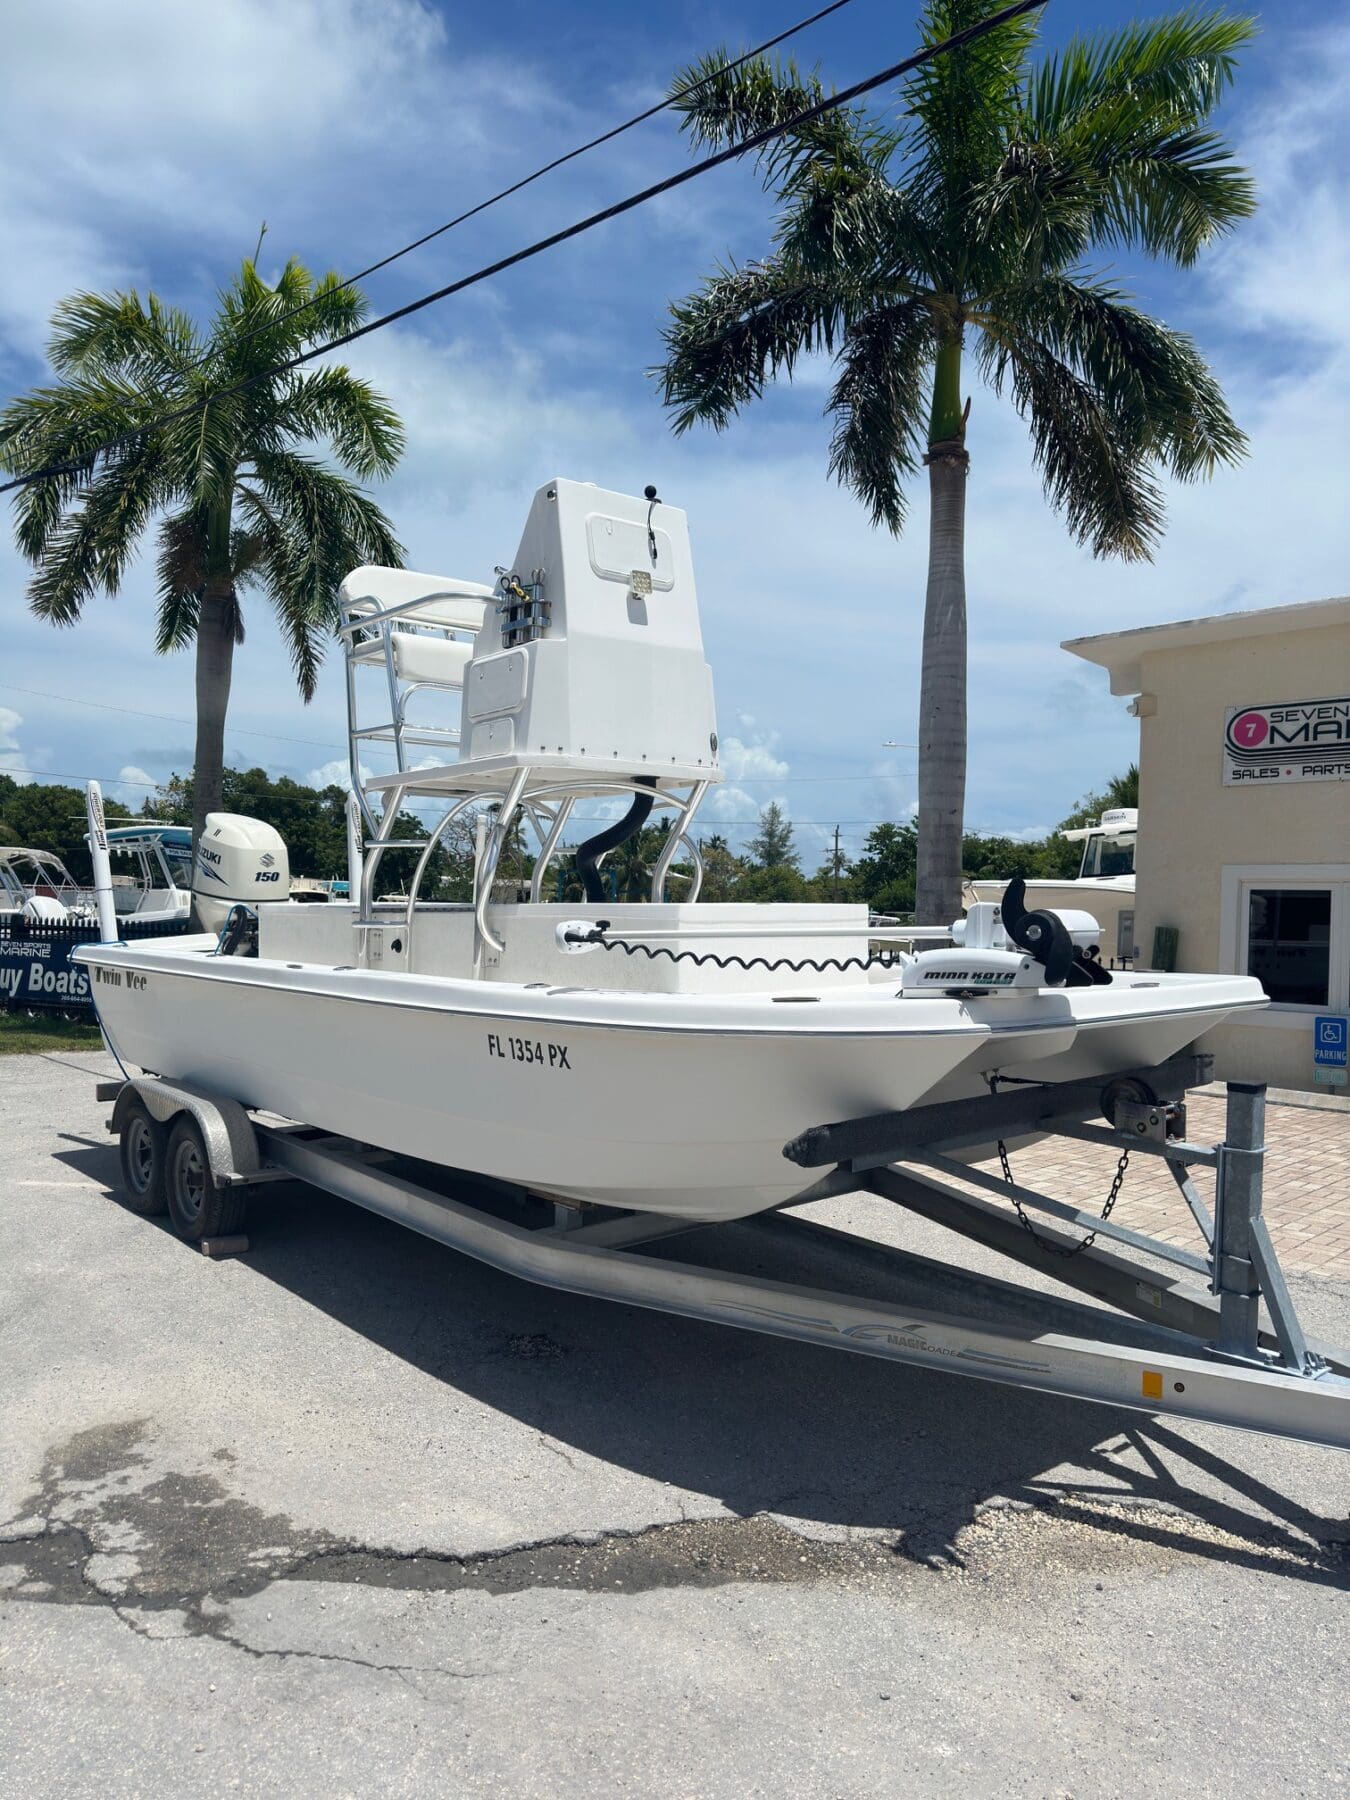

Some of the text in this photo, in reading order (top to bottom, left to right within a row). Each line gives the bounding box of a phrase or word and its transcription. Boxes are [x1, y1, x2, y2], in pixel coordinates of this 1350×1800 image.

[1270, 705, 1350, 723] SEVEN
[1246, 723, 1256, 738] 7
[1232, 767, 1280, 780] SALES
[200, 848, 222, 865] ZUKI
[255, 872, 280, 882] 150
[0, 948, 51, 958] MARINE
[0, 963, 89, 997] uy Boats
[95, 966, 147, 991] Twin Vee
[924, 972, 1017, 980] MINN KOTA
[488, 1034, 572, 1070] FL 1354 PX
[1315, 1049, 1347, 1061] PARKING
